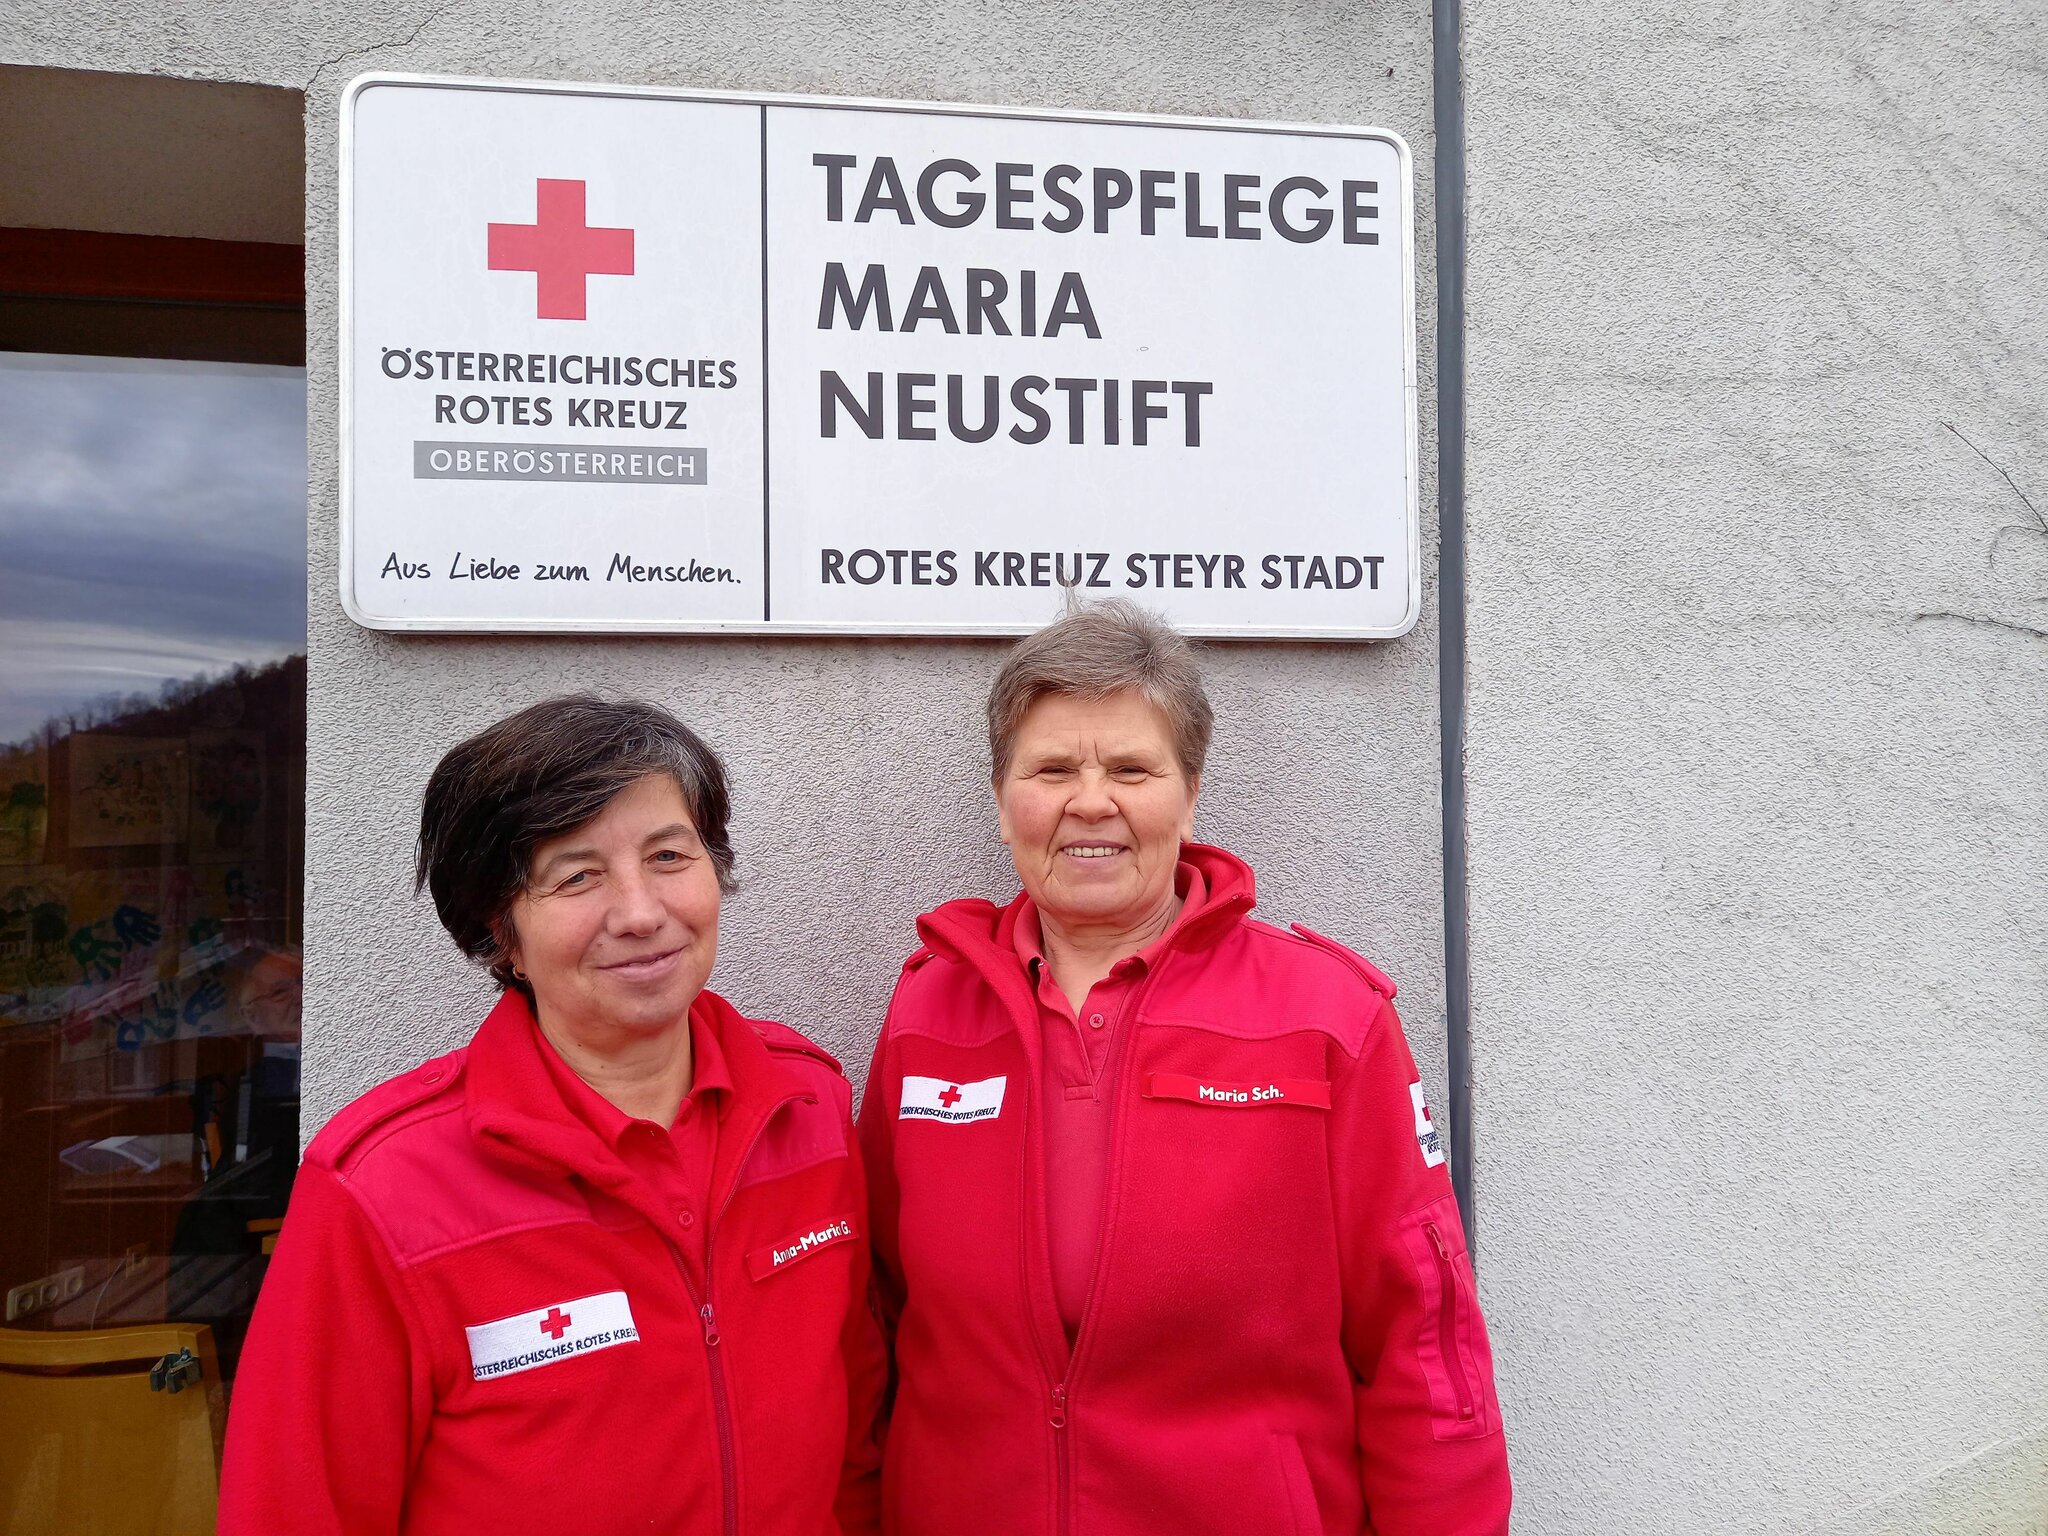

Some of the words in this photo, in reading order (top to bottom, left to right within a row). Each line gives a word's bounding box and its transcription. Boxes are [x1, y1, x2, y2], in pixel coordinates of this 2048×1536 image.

[813, 154, 1379, 245] TAGESPFLEGE
[818, 262, 1102, 339] MARIA
[381, 347, 738, 389] ÖSTERREICHISCHES
[436, 395, 552, 426] ROTES
[569, 399, 687, 430] KREUZ
[821, 371, 1213, 447] NEUSTIFT
[429, 447, 695, 477] OBERÖSTERREICH
[381, 551, 431, 580] Aus
[449, 552, 521, 580] Liebe
[534, 563, 589, 582] zum
[606, 552, 742, 584] Menschen.
[822, 549, 957, 586] ROTES
[974, 551, 1111, 588] KREUZ
[1126, 553, 1247, 589] STEYR
[1261, 555, 1385, 590] STADT
[1198, 1085, 1248, 1103] Maria
[1251, 1085, 1284, 1102] Sch.
[953, 1111, 974, 1121] ROTES
[974, 1106, 997, 1118] KREUZ
[840, 1220, 852, 1236] G.
[576, 1332, 611, 1350] ROTES
